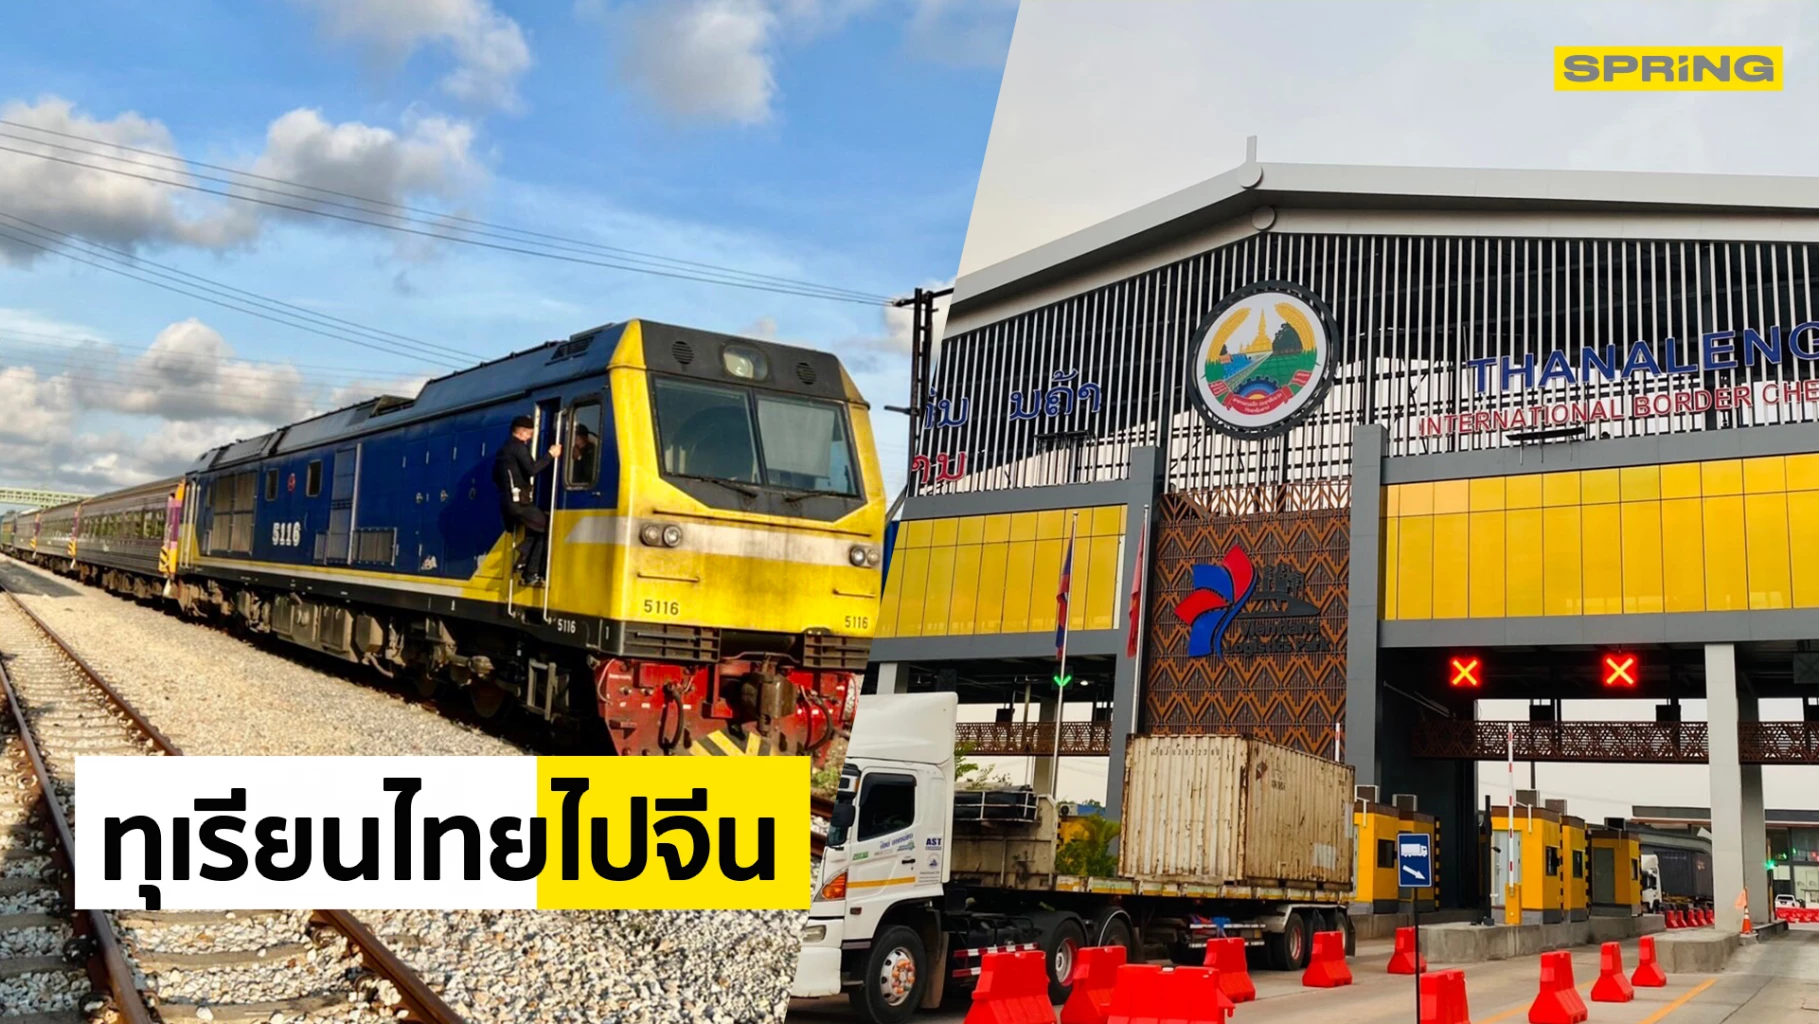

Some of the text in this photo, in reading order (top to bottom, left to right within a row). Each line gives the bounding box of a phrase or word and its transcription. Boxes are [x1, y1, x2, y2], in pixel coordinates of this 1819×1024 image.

[1466, 321, 1819, 394] THANALENG
[1419, 400, 1625, 438] INTERNATIONAL
[1633, 385, 1753, 419] BORDER
[272, 521, 301, 547] 5116
[643, 599, 680, 616] 5116
[556, 618, 577, 634] 5116
[844, 615, 869, 630] 5116
[926, 837, 942, 846] AST
